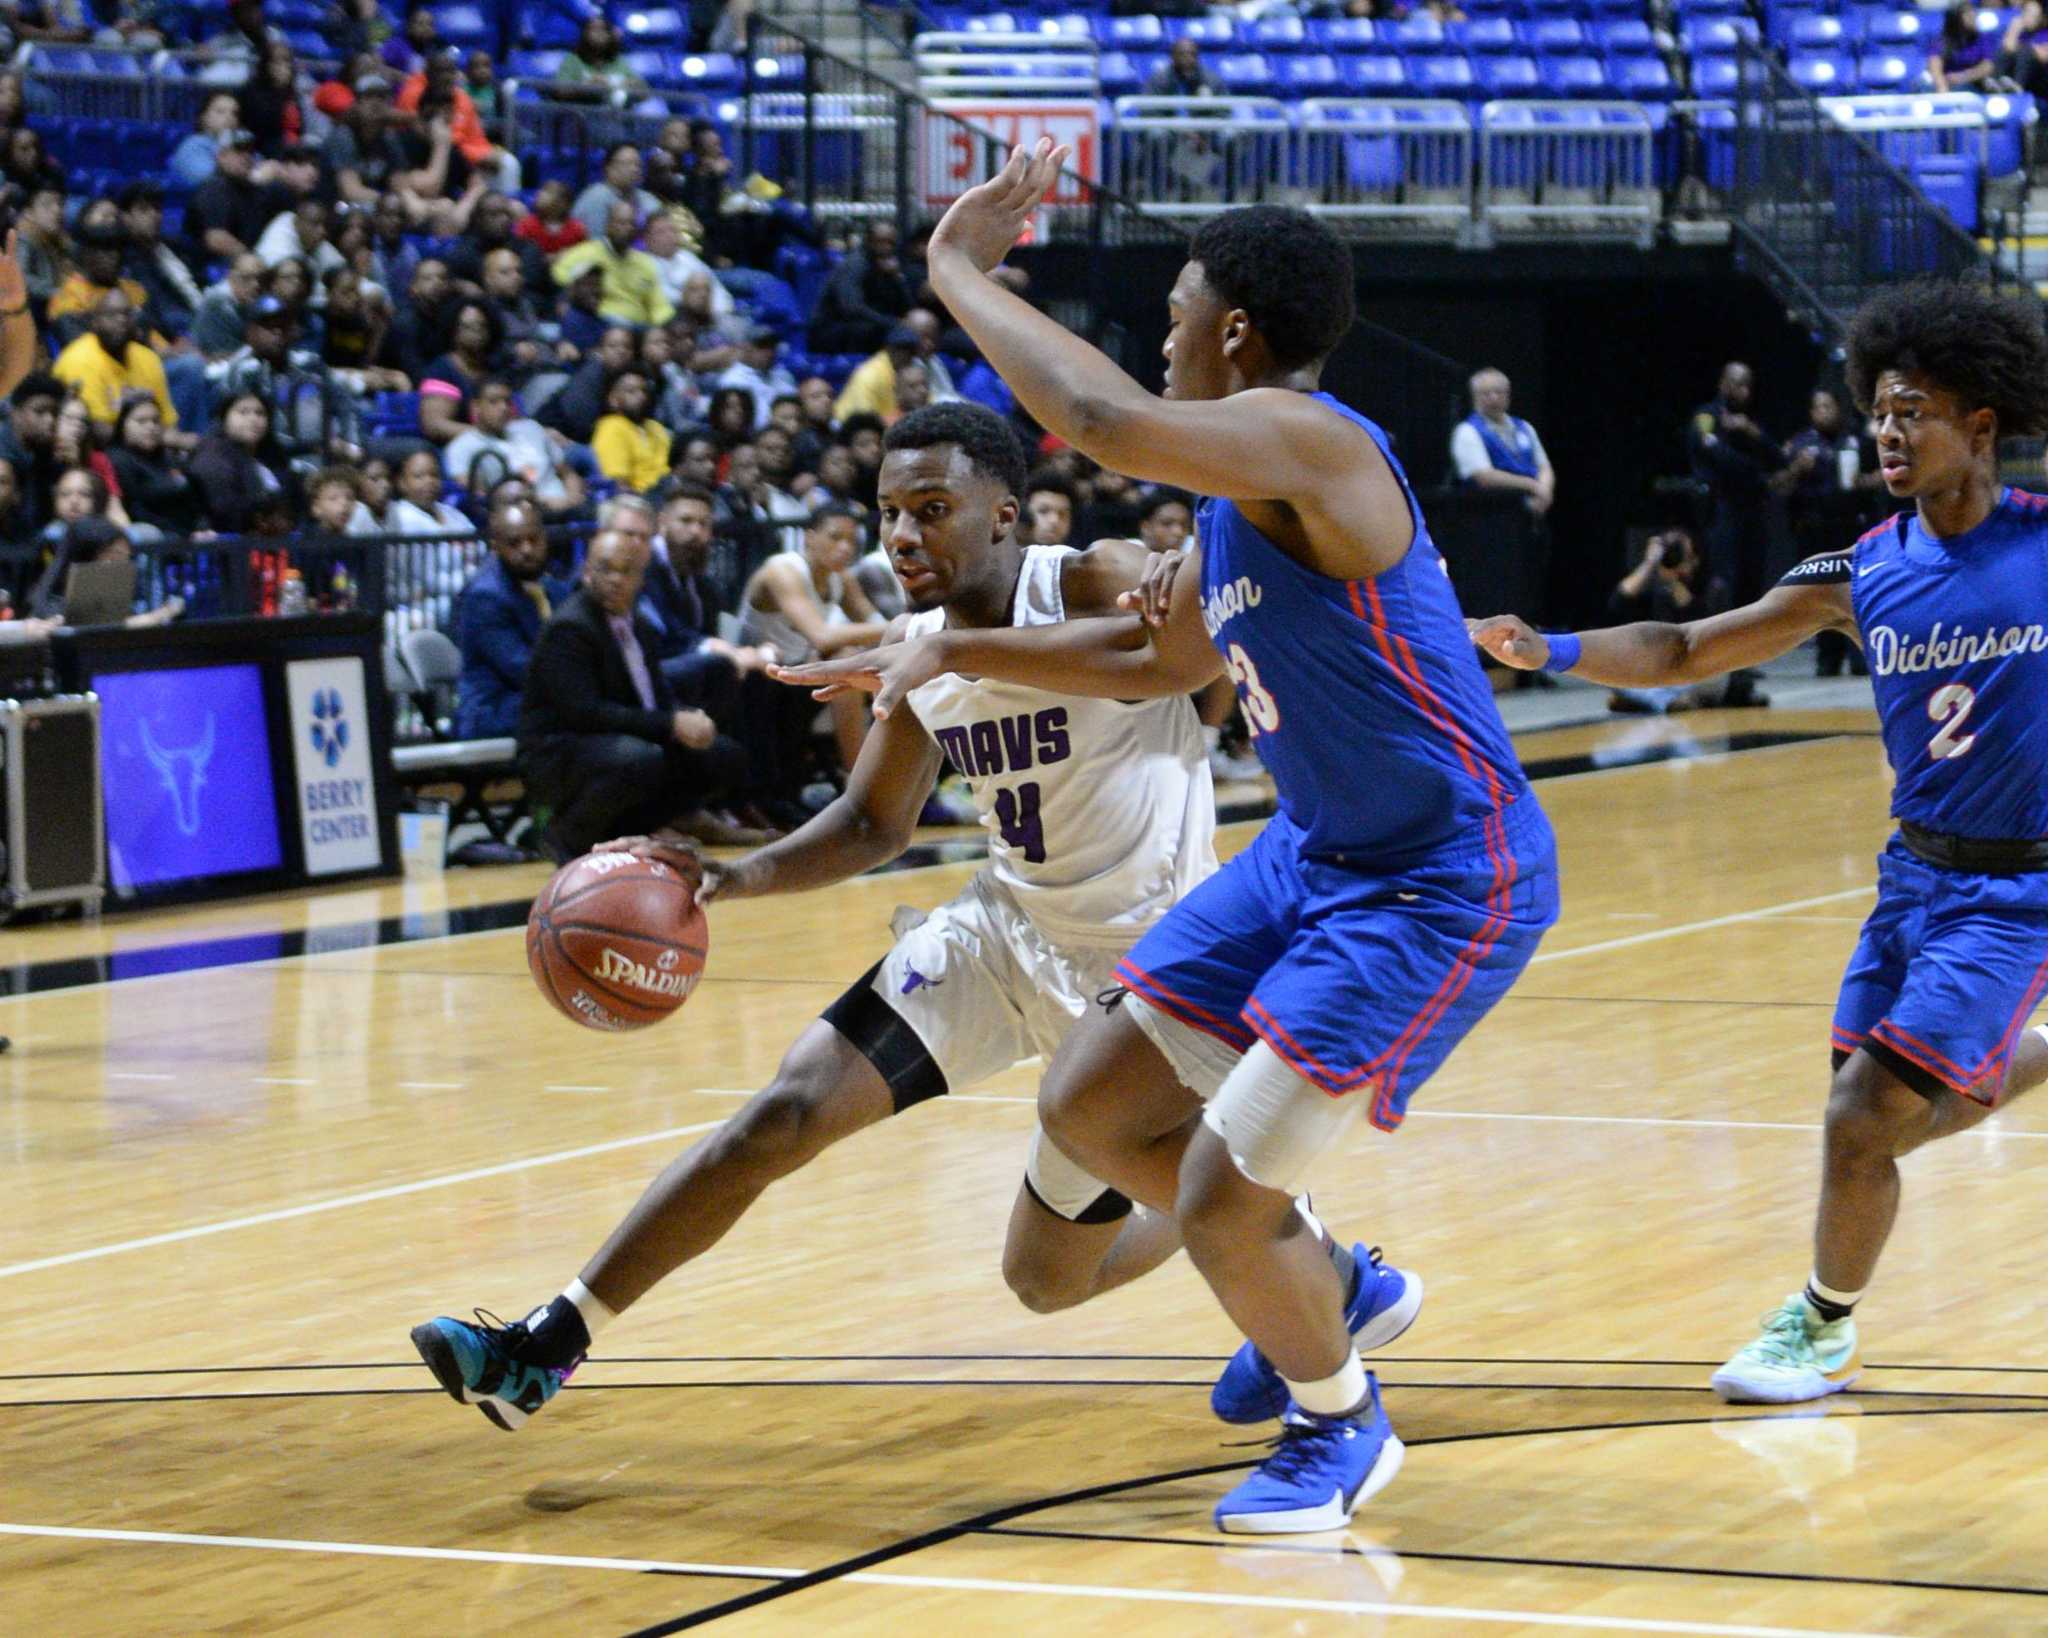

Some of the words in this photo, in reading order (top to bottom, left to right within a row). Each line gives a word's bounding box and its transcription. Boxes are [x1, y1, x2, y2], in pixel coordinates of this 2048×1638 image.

[1870, 622, 2048, 676] Dickinson
[934, 706, 1071, 777] MAVS
[1928, 683, 1976, 760] 2
[306, 779, 365, 811] BERRY
[311, 814, 370, 844] CENTER
[995, 782, 1046, 864] 4
[593, 947, 699, 997] SPALDIN
